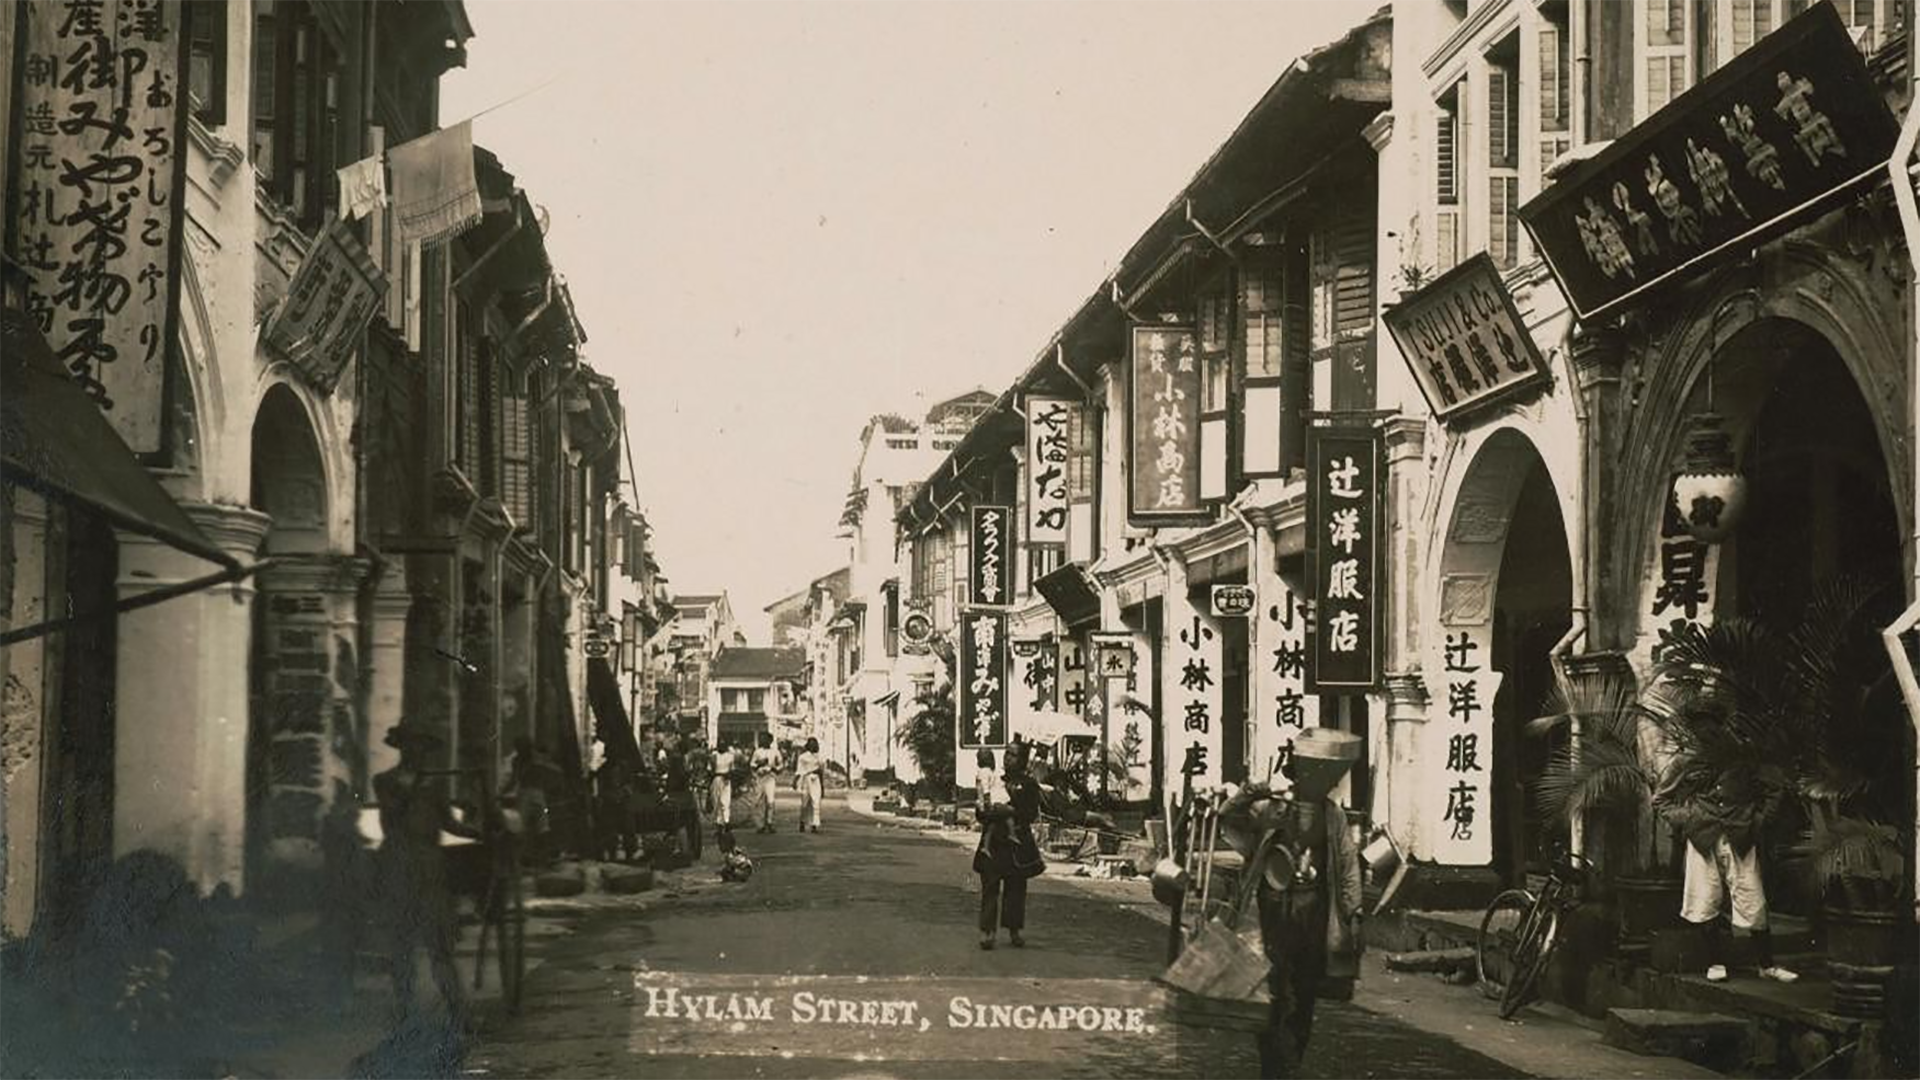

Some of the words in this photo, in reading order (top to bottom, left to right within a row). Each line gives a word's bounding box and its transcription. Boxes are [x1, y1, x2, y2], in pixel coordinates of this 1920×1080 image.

[1399, 301, 1463, 360] TSUJI
[1453, 291, 1478, 331] &
[1154, 373, 1187, 507] 小林商店
[1328, 456, 1364, 652] 辻洋服店
[1180, 616, 1214, 776] 小林商店
